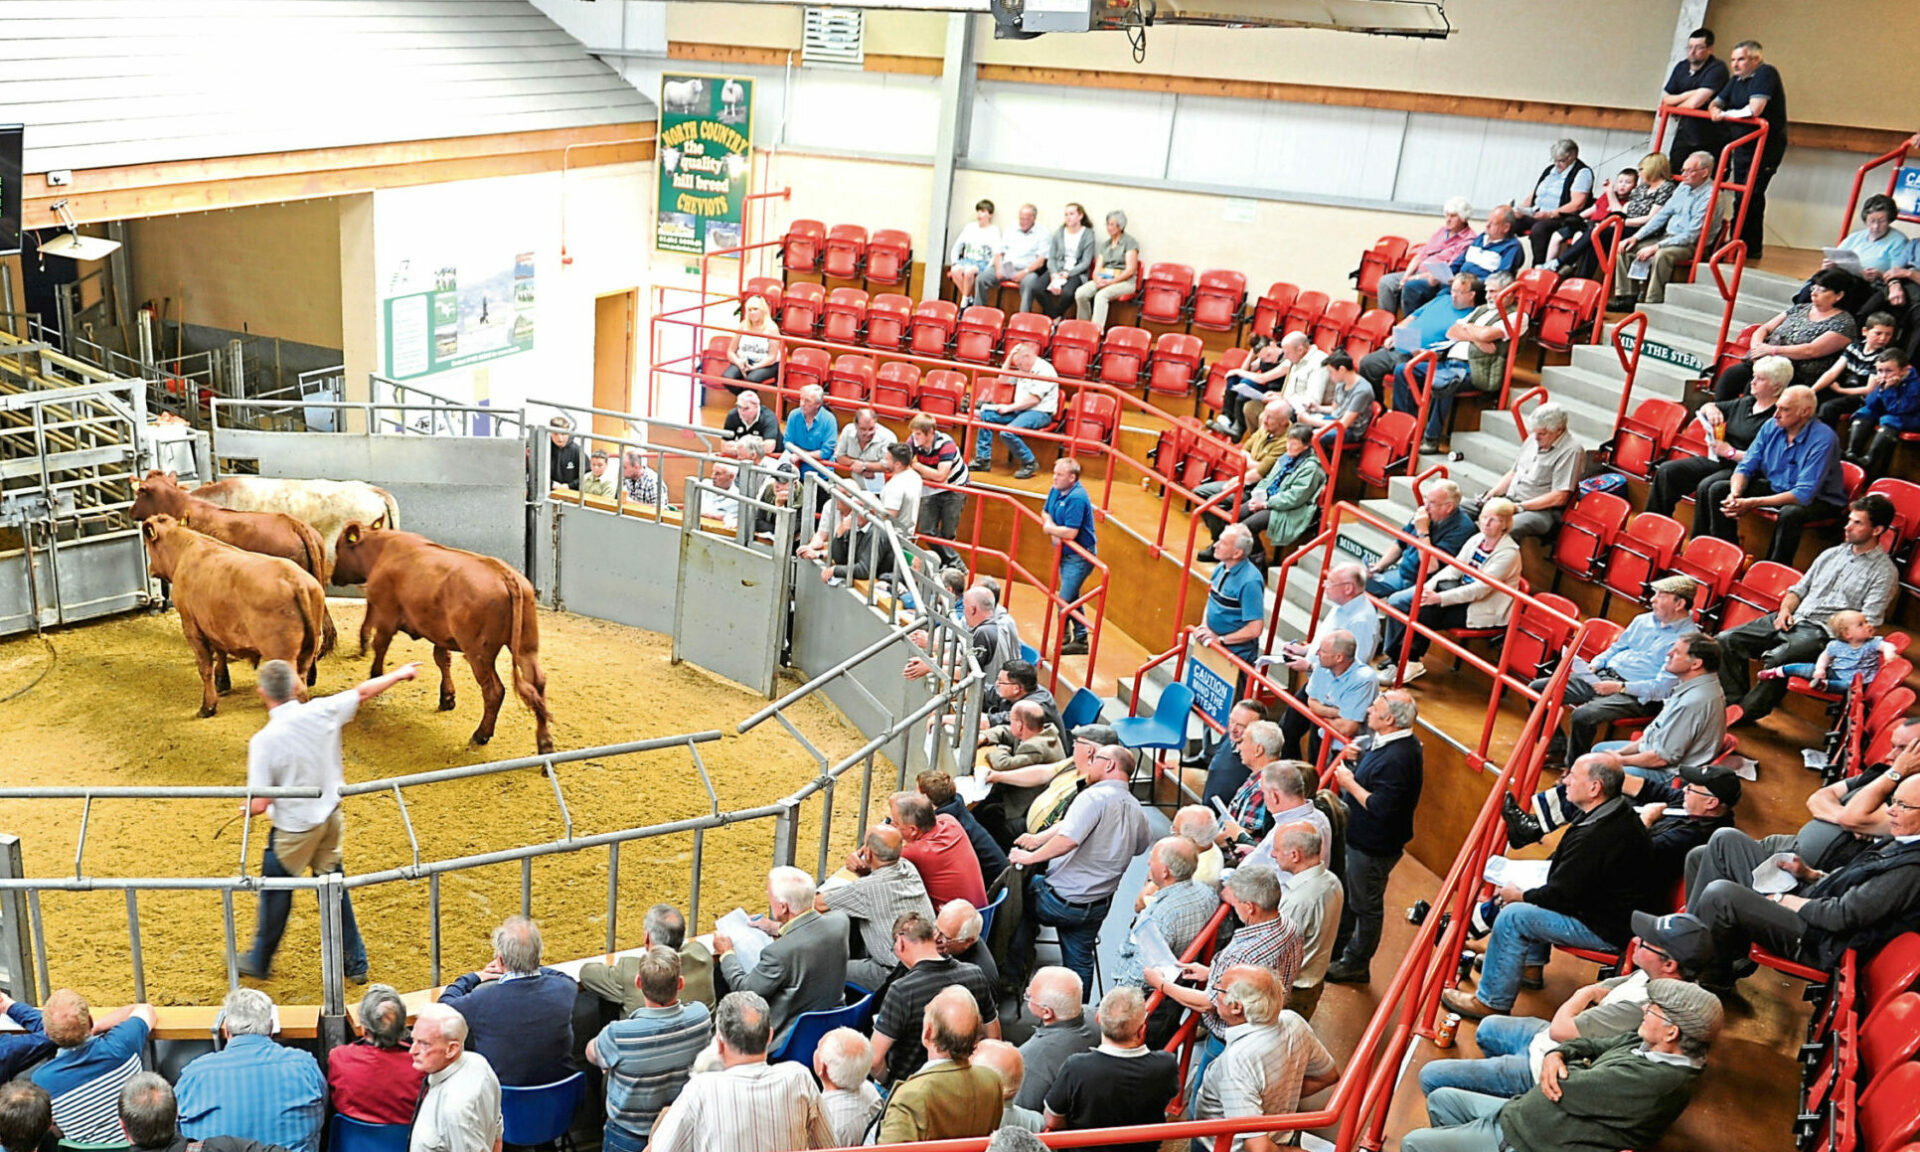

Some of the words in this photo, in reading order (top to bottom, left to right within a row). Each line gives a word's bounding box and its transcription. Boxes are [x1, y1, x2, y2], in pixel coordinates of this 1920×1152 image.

[662, 120, 698, 148] NORTH
[700, 120, 749, 155] COUNTRY
[684, 140, 705, 155] the
[680, 156, 723, 175] quality
[673, 172, 695, 188] hill
[696, 175, 730, 193] breed
[676, 193, 729, 216] CHEVIOTS
[1618, 335, 1645, 352] MIN
[1646, 344, 1669, 359] THE
[1670, 351, 1703, 368] STEPS
[1339, 536, 1362, 556] MIND
[1194, 665, 1228, 698] CAUTION
[1192, 678, 1210, 698] MIND
[1210, 692, 1225, 710] THE
[1195, 693, 1218, 717] STEPS
